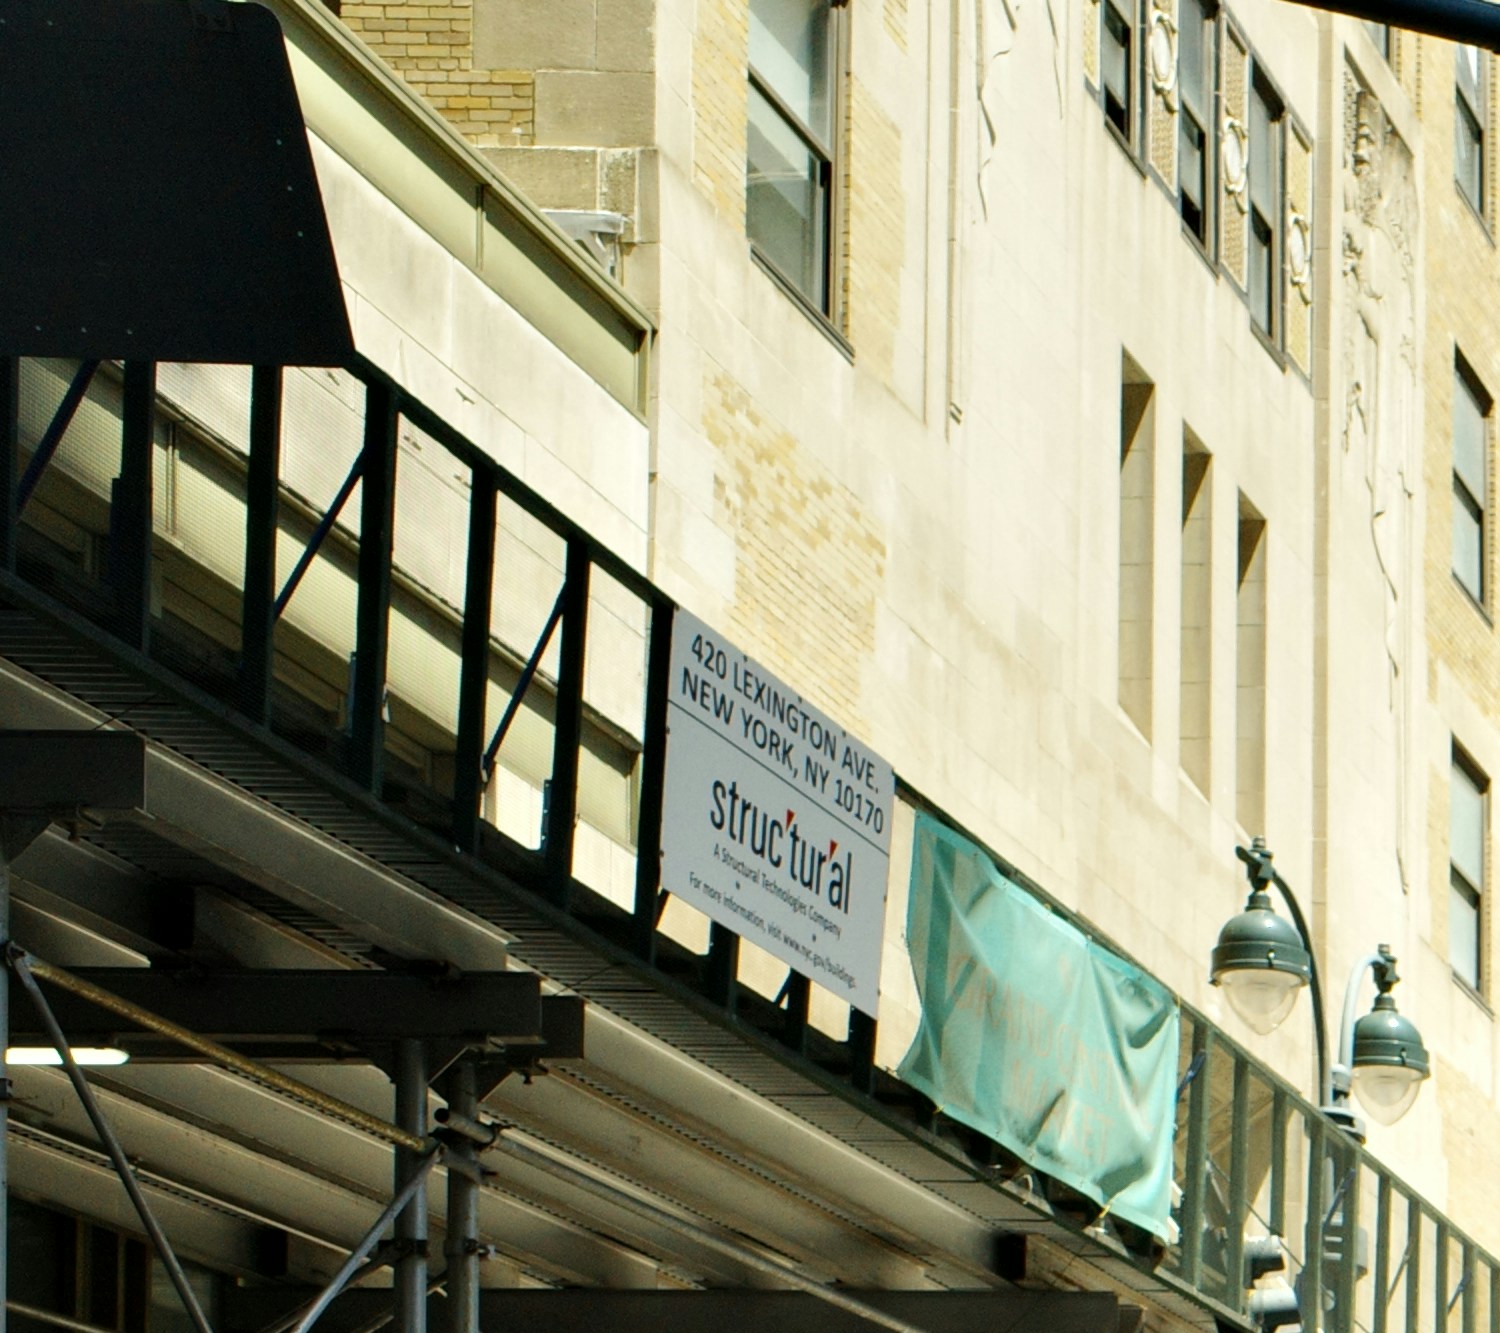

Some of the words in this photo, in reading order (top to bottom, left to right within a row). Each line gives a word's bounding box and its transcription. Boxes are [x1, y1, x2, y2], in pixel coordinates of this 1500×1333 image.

[682, 666, 735, 726] NEW
[741, 707, 800, 779] YORK,
[804, 755, 831, 795] NY
[834, 778, 885, 835] 10170
[691, 633, 727, 680] 420
[733, 661, 838, 761] LEXINGTON
[841, 745, 880, 795] AVE.
[689, 870, 702, 890] For
[702, 880, 722, 903] more
[767, 918, 782, 939] visit
[713, 843, 721, 858] A
[721, 847, 761, 886] Structural
[761, 873, 809, 917] Technologies
[808, 904, 843, 941] Company
